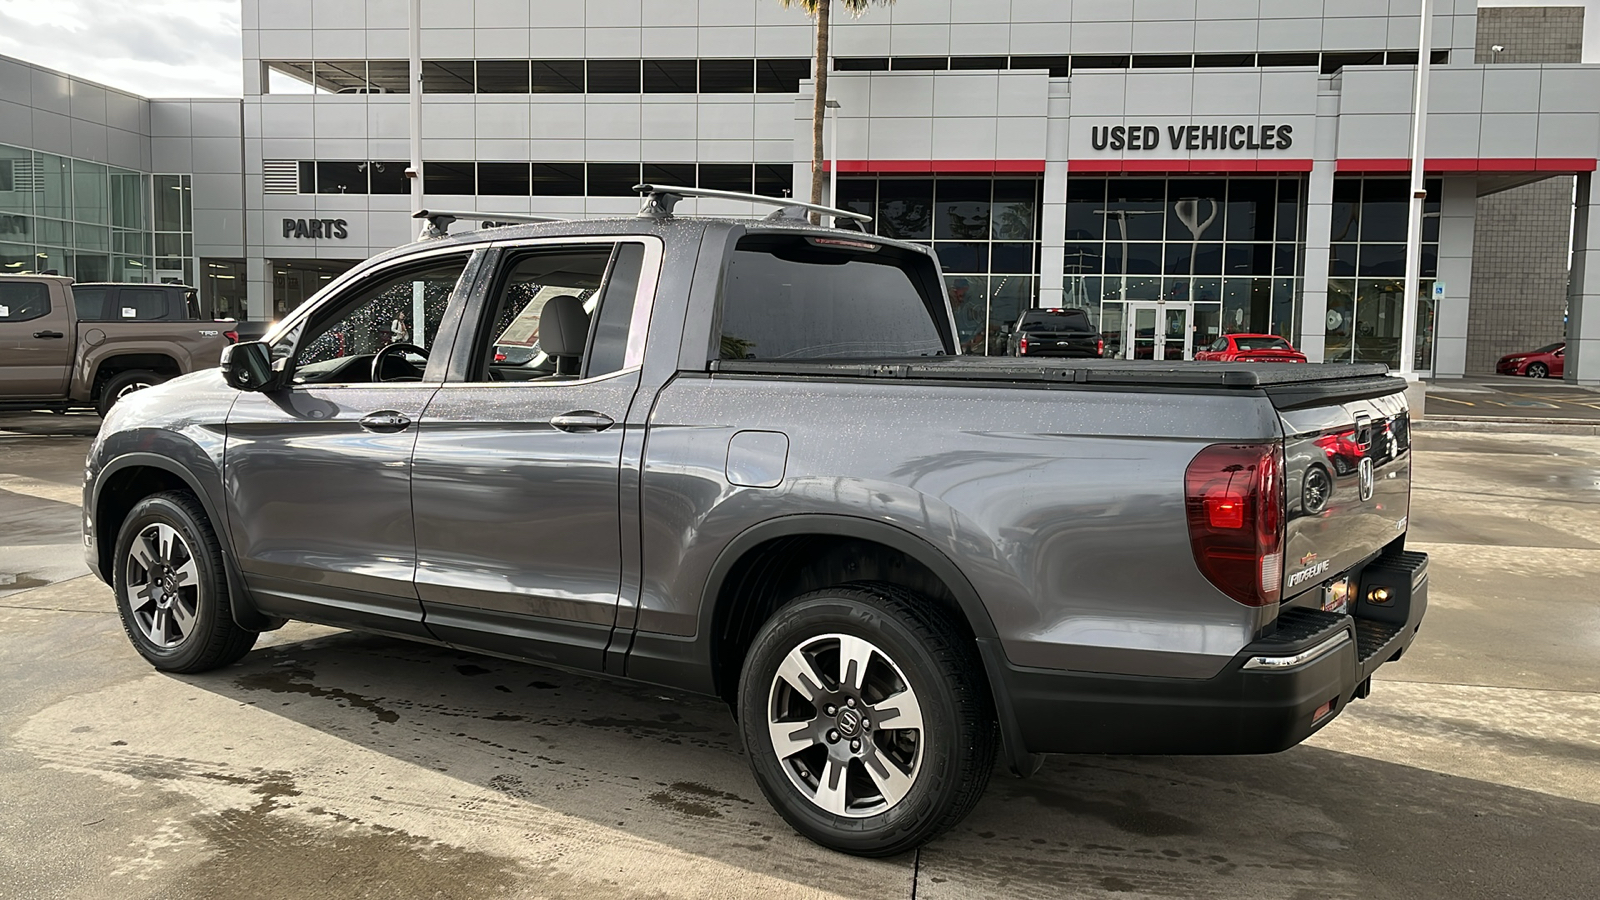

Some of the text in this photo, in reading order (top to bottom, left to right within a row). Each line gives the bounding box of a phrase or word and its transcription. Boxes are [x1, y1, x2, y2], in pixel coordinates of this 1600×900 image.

[1091, 124, 1293, 150] USED VEHICLES
[283, 218, 348, 240] PARTS
